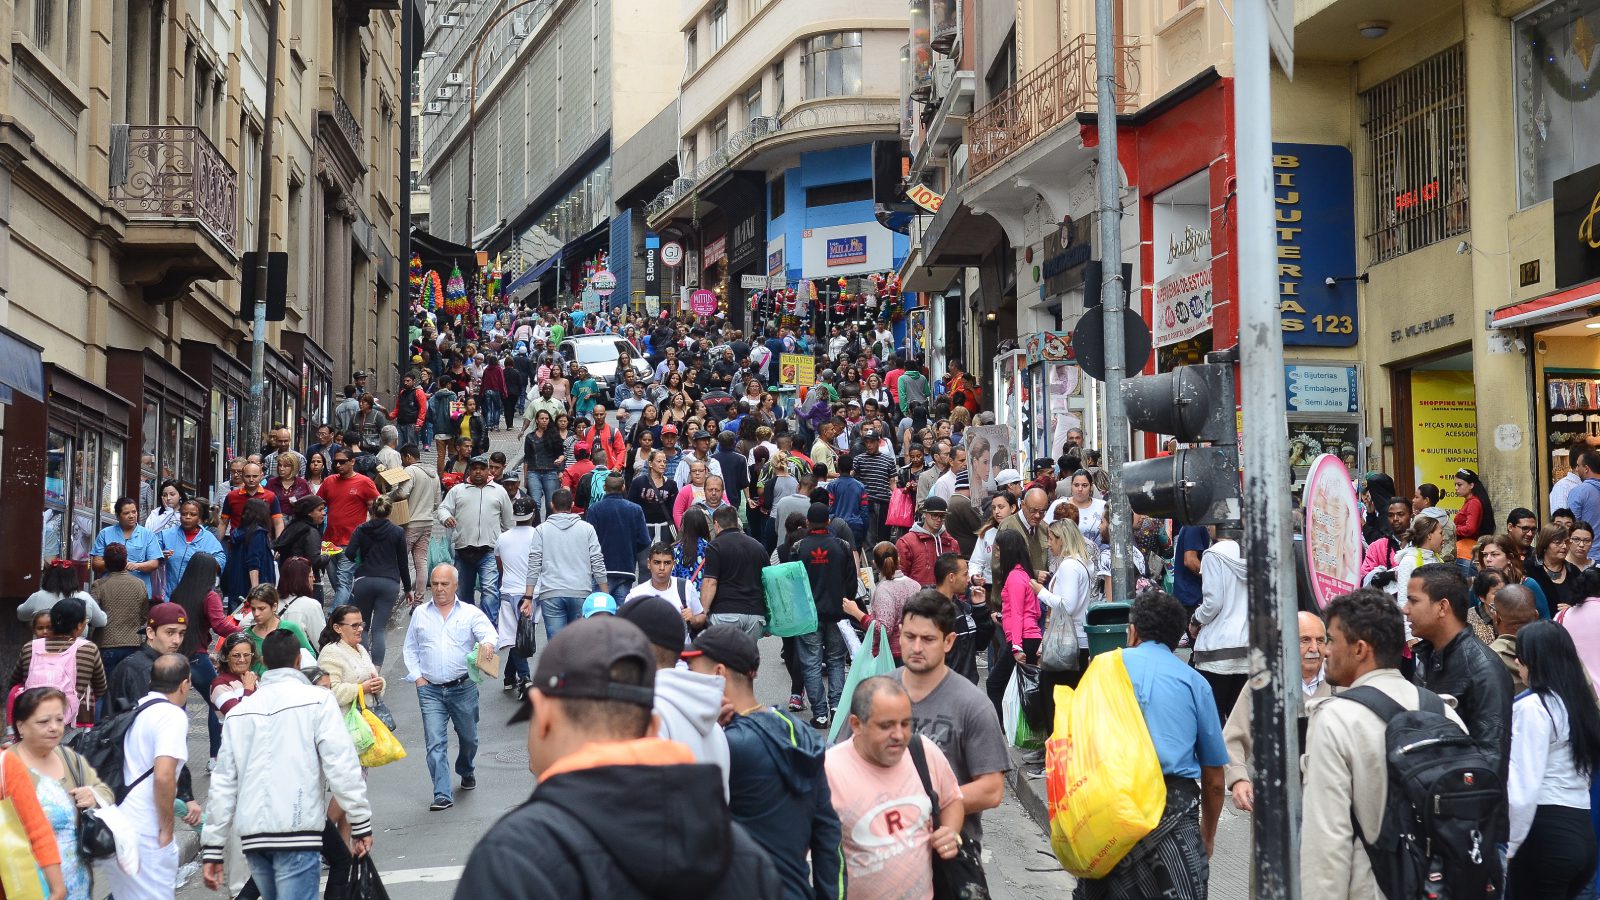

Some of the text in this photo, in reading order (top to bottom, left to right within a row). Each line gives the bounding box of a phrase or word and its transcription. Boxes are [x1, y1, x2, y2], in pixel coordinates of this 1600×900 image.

[912, 186, 943, 211] 103
[803, 230, 812, 238] 85
[1272, 155, 1306, 333] BIJUTERIAS
[664, 246, 679, 258] GJ
[646, 249, 655, 281] S.Bento
[1312, 315, 1353, 334] 123
[1304, 371, 1338, 380] Bijuterias
[1304, 385, 1347, 393] Embalagens
[1305, 398, 1323, 406] Semi
[1424, 422, 1445, 430] PEÇAS
[885, 810, 904, 835] R
